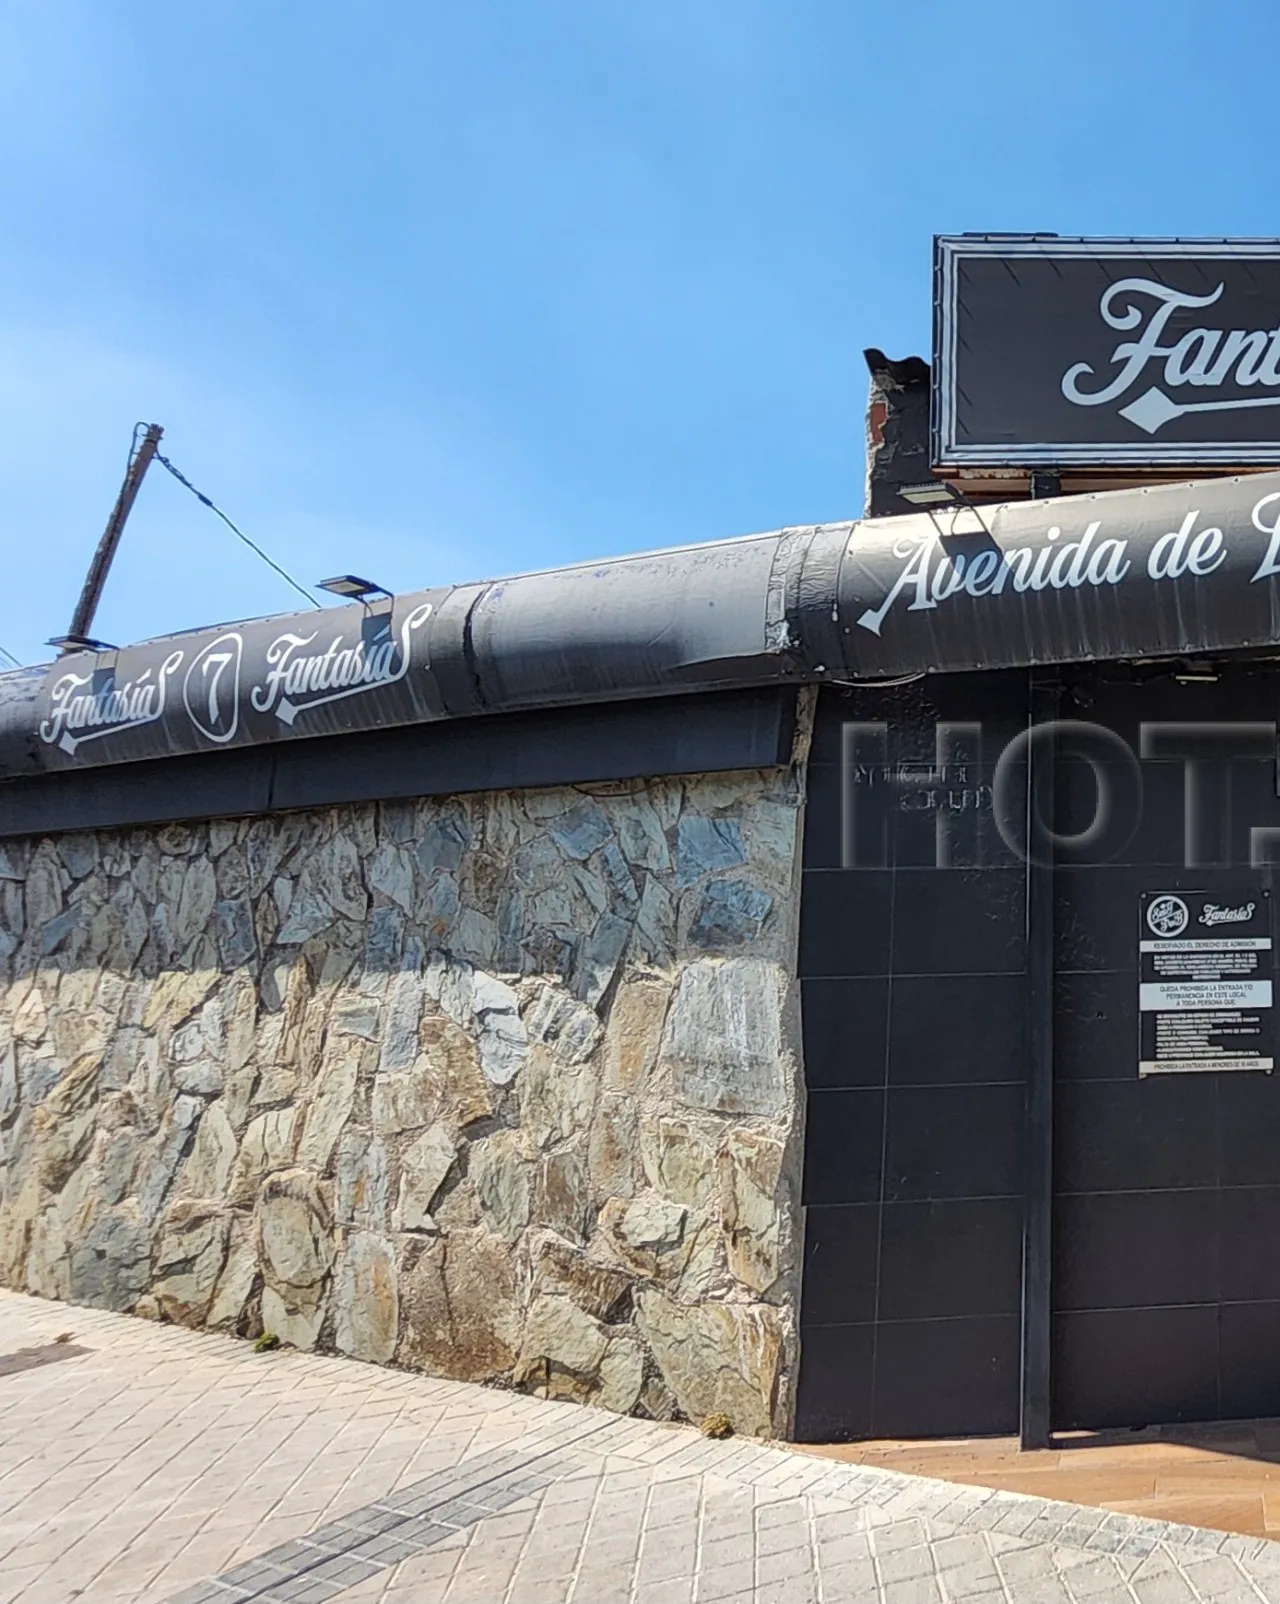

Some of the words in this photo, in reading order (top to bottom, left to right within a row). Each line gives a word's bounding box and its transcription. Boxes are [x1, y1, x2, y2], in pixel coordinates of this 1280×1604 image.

[858, 513, 1131, 637] Avenida
[1147, 509, 1227, 576] de
[201, 652, 233, 725] 7
